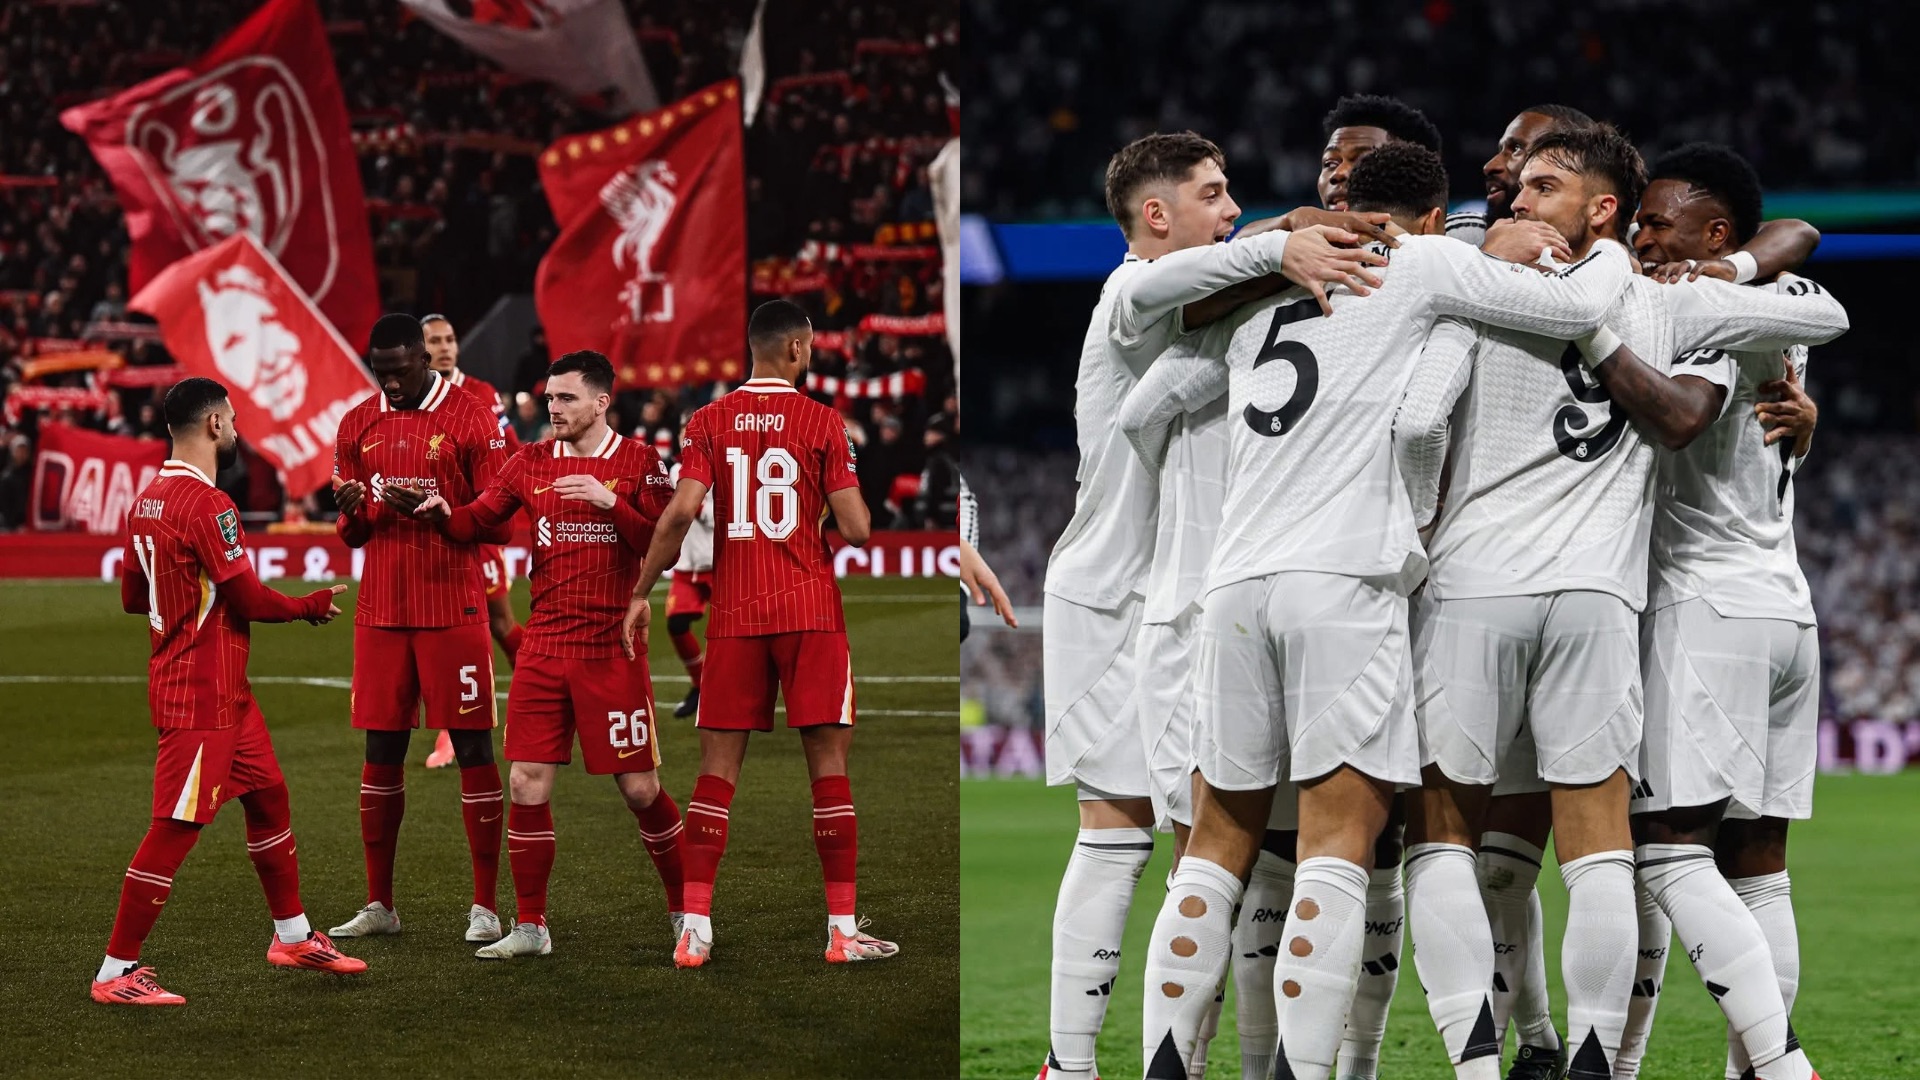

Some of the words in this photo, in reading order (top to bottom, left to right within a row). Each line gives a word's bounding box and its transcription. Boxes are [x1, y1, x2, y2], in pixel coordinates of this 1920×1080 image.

[1243, 288, 1335, 437] 5
[1553, 339, 1628, 462] 9
[734, 413, 785, 432] GAKPO
[726, 447, 800, 541] 18
[556, 531, 618, 543] chartered
[133, 534, 164, 633] 11
[483, 560, 499, 586] 4
[459, 665, 478, 702] 5
[608, 708, 648, 748] 26
[702, 826, 722, 836] LFC
[817, 829, 837, 837] LFC
